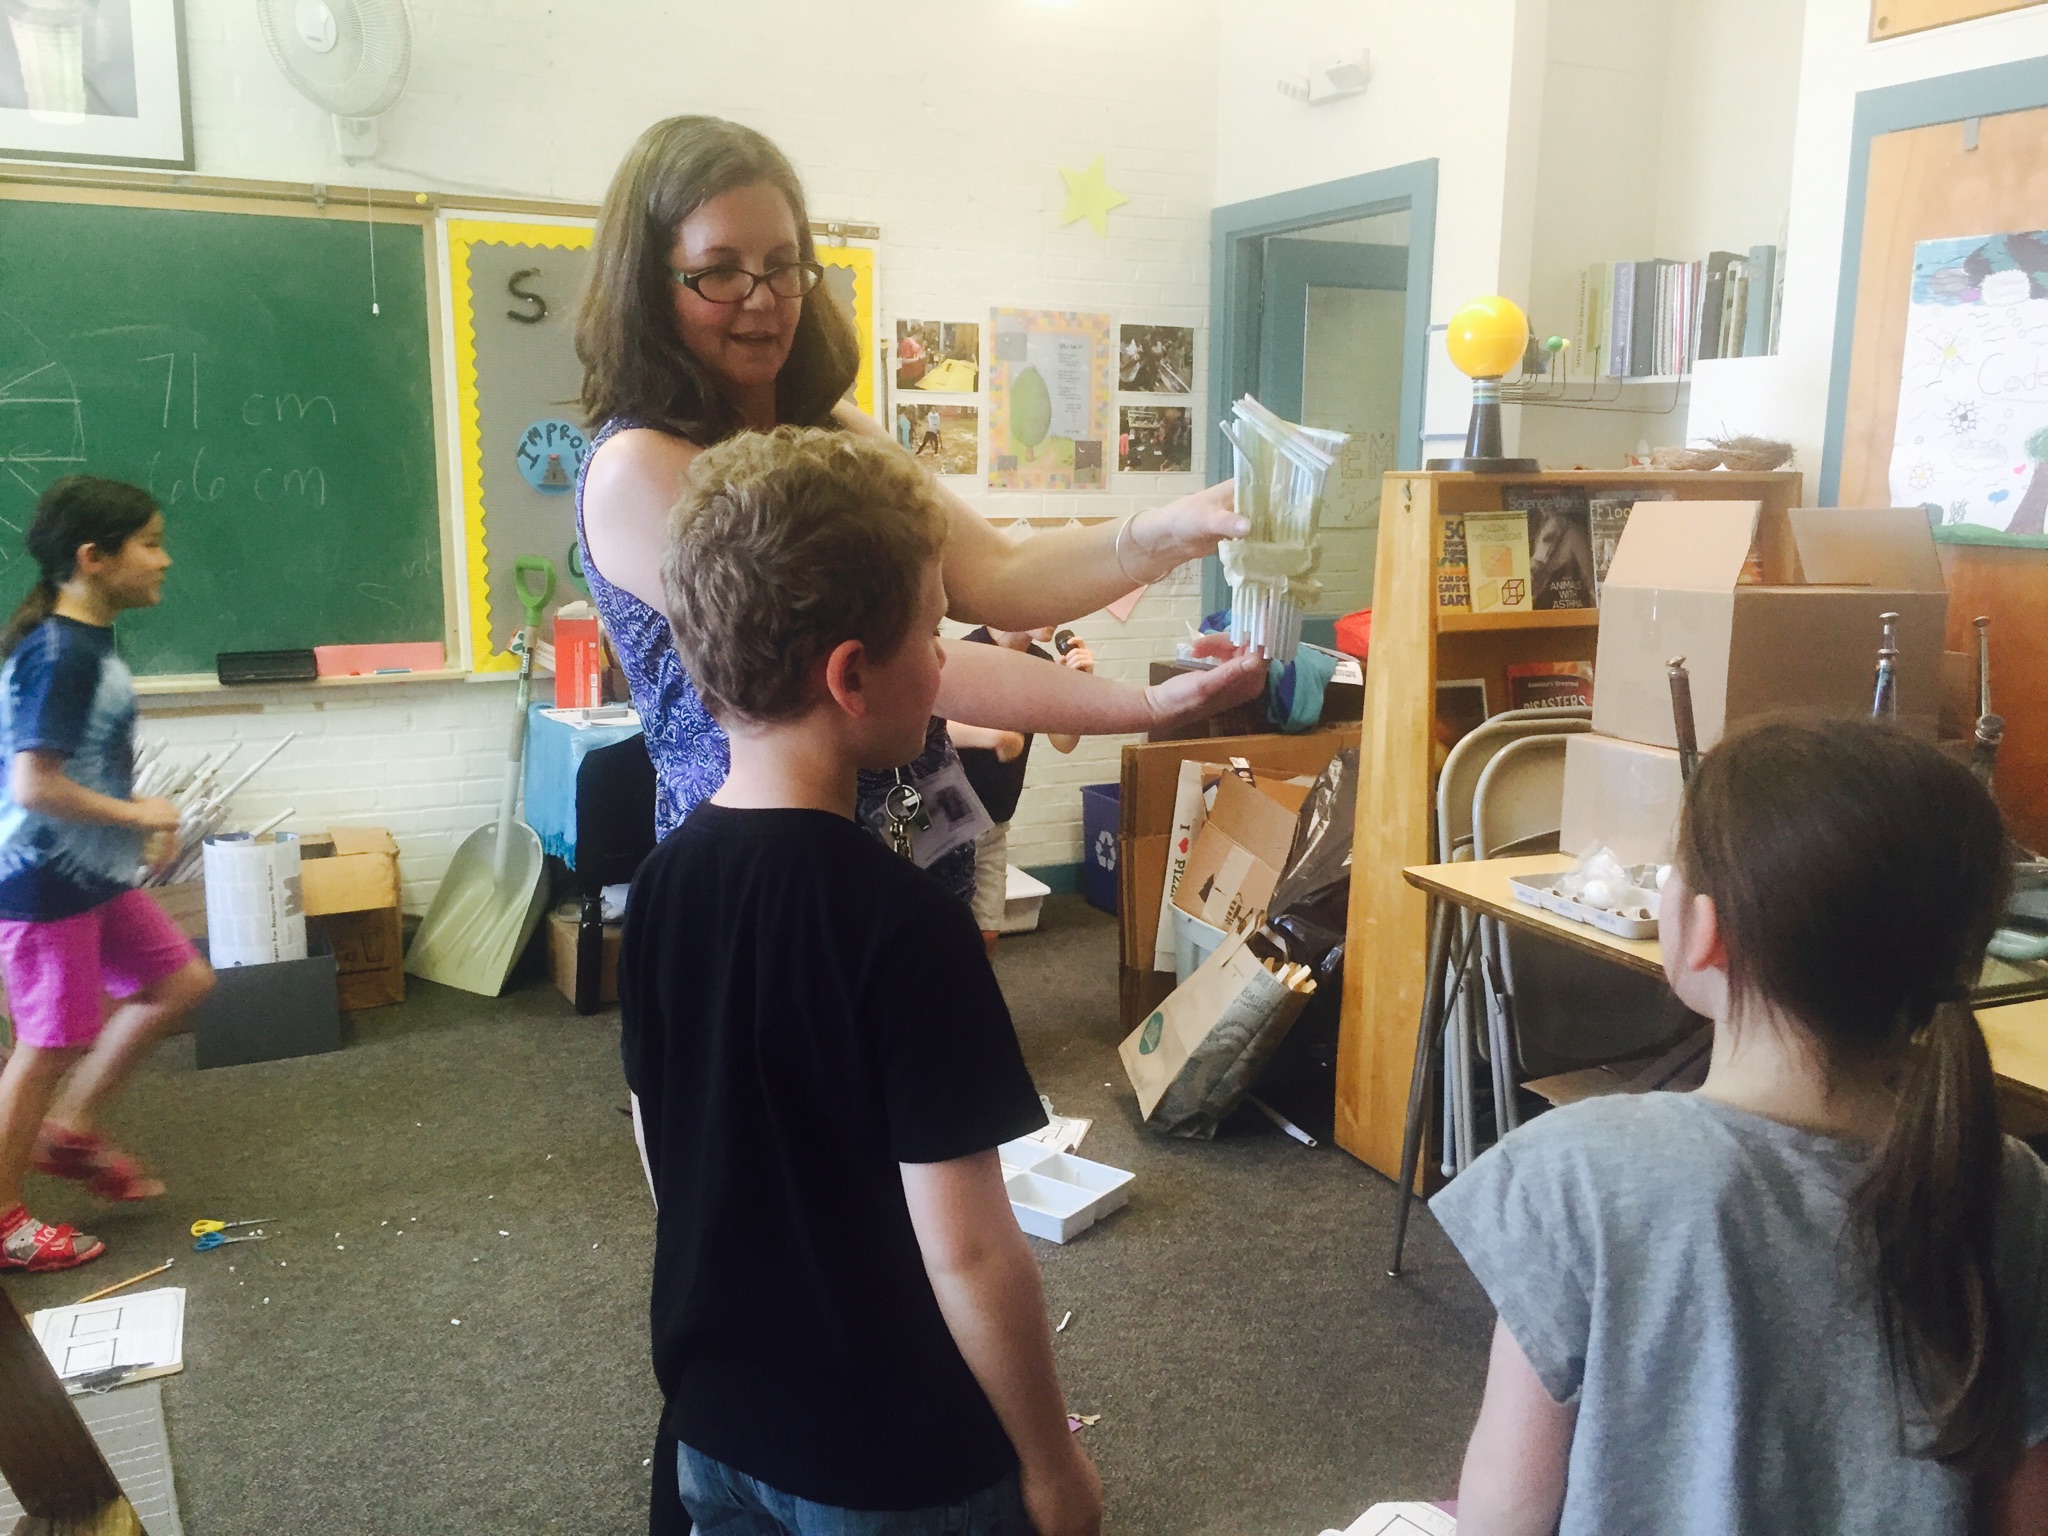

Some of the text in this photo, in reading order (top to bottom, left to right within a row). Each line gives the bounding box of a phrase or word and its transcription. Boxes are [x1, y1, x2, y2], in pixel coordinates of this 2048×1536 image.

[137, 352, 338, 429] 71 cm
[517, 423, 586, 479] IMPROV
[254, 466, 327, 506] cm
[1595, 504, 1632, 520] Floo
[1444, 520, 1466, 540] 50
[1438, 584, 1462, 593] SAVE
[1439, 594, 1470, 606] EART
[1169, 858, 1187, 898] PIZZ
